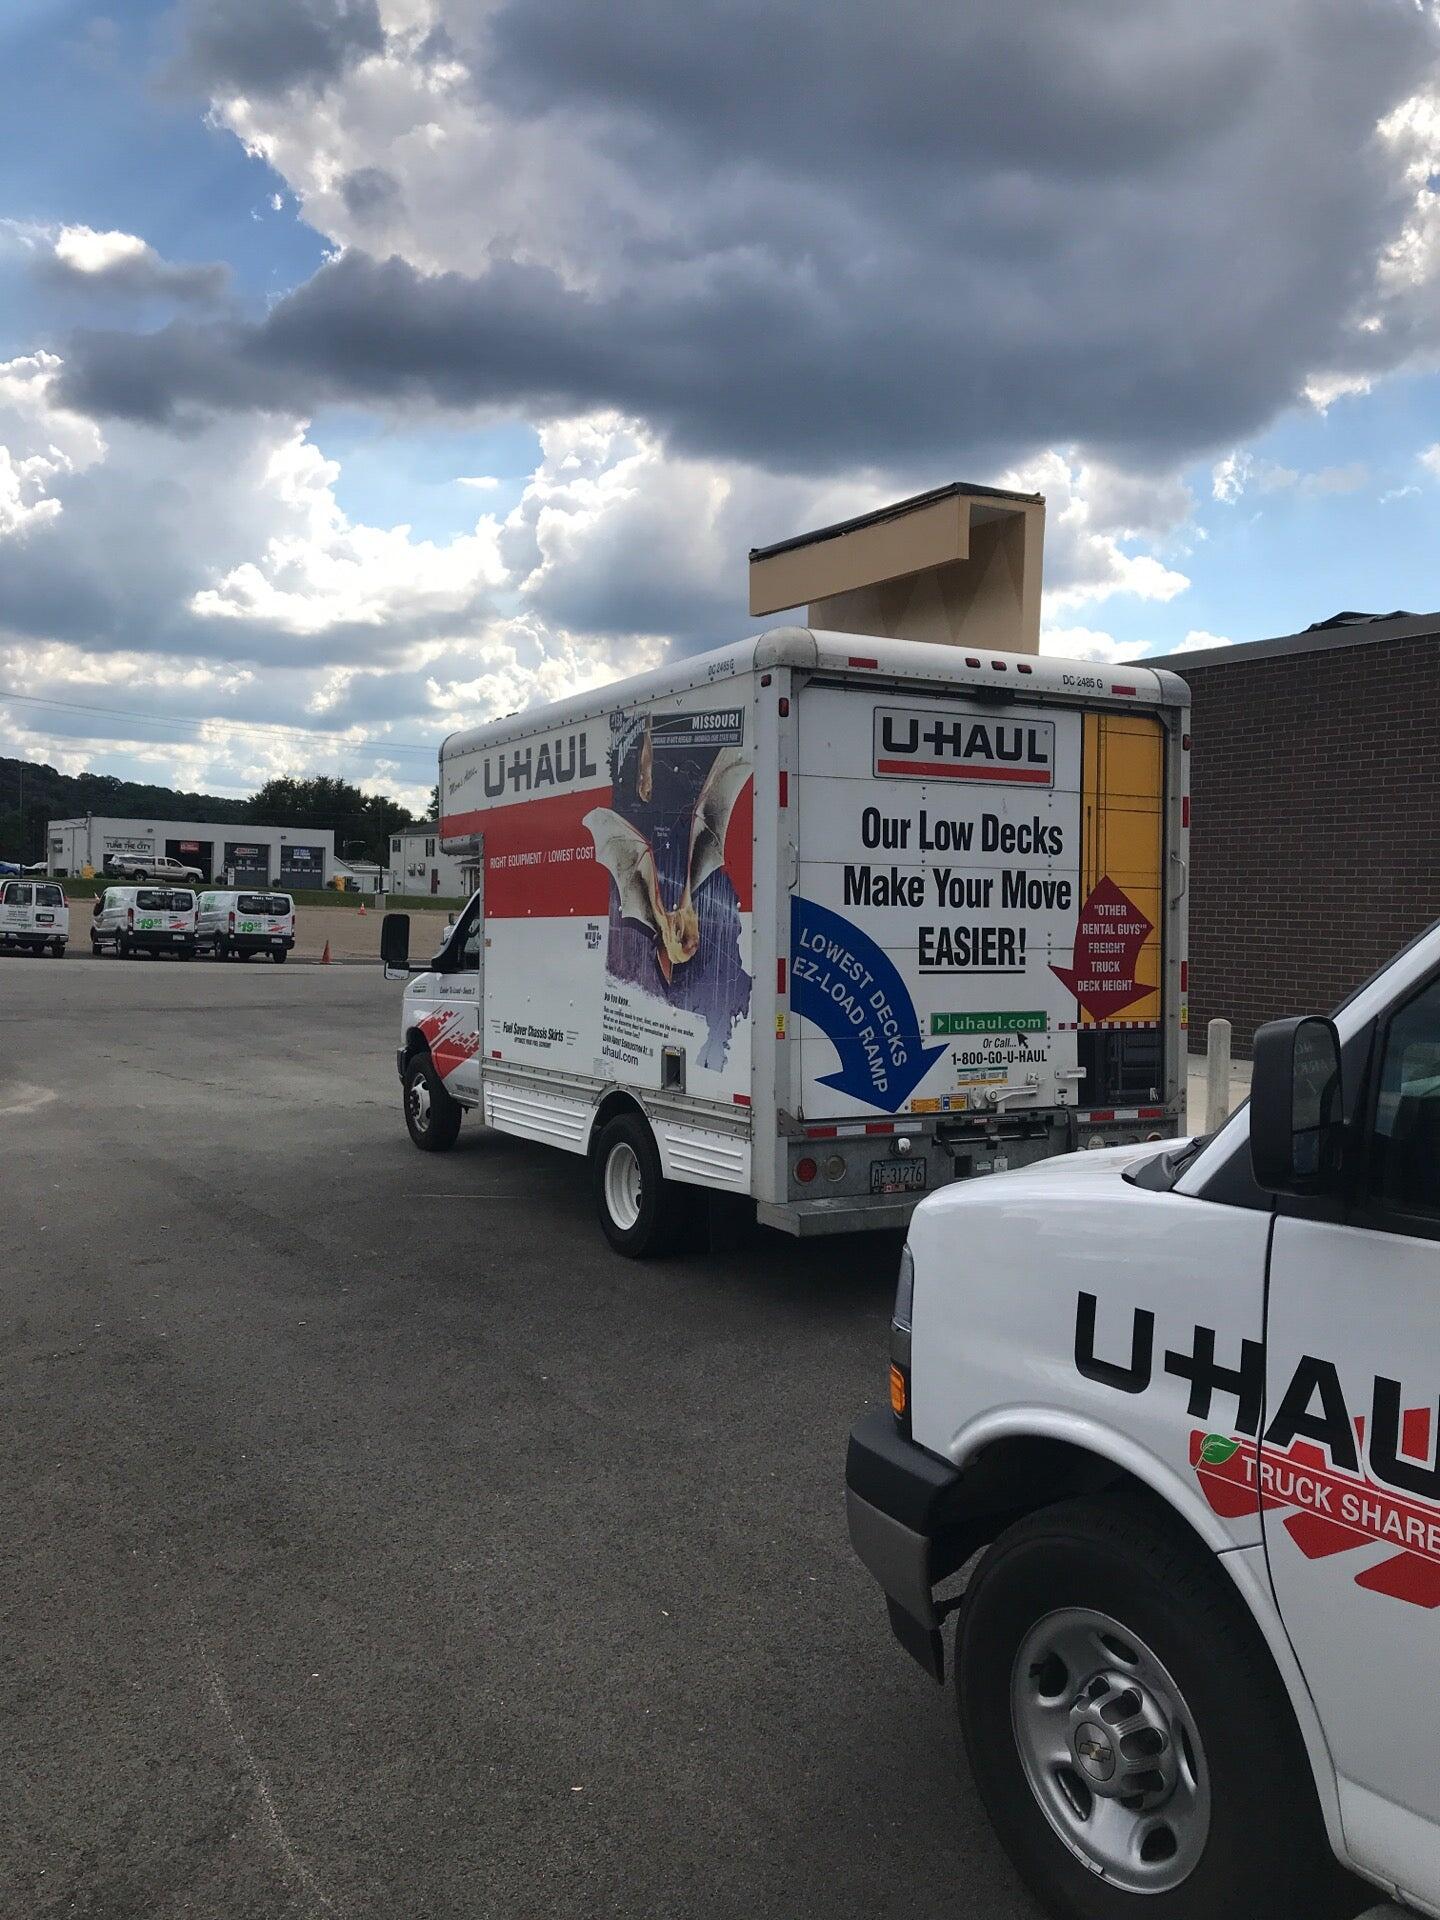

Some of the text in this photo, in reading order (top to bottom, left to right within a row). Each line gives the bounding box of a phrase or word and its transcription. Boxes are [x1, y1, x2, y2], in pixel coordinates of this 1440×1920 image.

[1063, 674, 1103, 689] DC 2485 G
[692, 713, 739, 730] MISSOURI
[882, 716, 1049, 764] U-HAUL
[484, 732, 597, 798] U-HAUL
[861, 806, 1064, 856] Our Low Decks
[136, 842, 151, 850] CITY
[490, 856, 507, 869] RIGHT
[508, 852, 542, 867] EQUIPMENT
[548, 848, 574, 863] LOWEST
[575, 846, 594, 860] COST
[843, 865, 1072, 910] Make Your Move
[1082, 923, 1115, 935] RENTAL
[918, 926, 1027, 967] EASIER!
[1088, 942, 1126, 954] FREIGHT
[1091, 960, 1120, 973] TRUCK
[1077, 979, 1132, 992] DECK HEIGHT
[800, 928, 907, 1067] LOWEST DECKS
[503, 1021, 564, 1042] Fuel Saver Chassis Skirts
[791, 956, 888, 1093] EZ-LOAD RAMP
[954, 1015, 1041, 1031] uhaul.com
[982, 1037, 1017, 1048] Or Call...
[602, 1045, 639, 1066] uhaul.com
[951, 1049, 1048, 1065] 1-800-GO-U-HAUL
[1241, 1453, 1334, 1513] TRUCK
